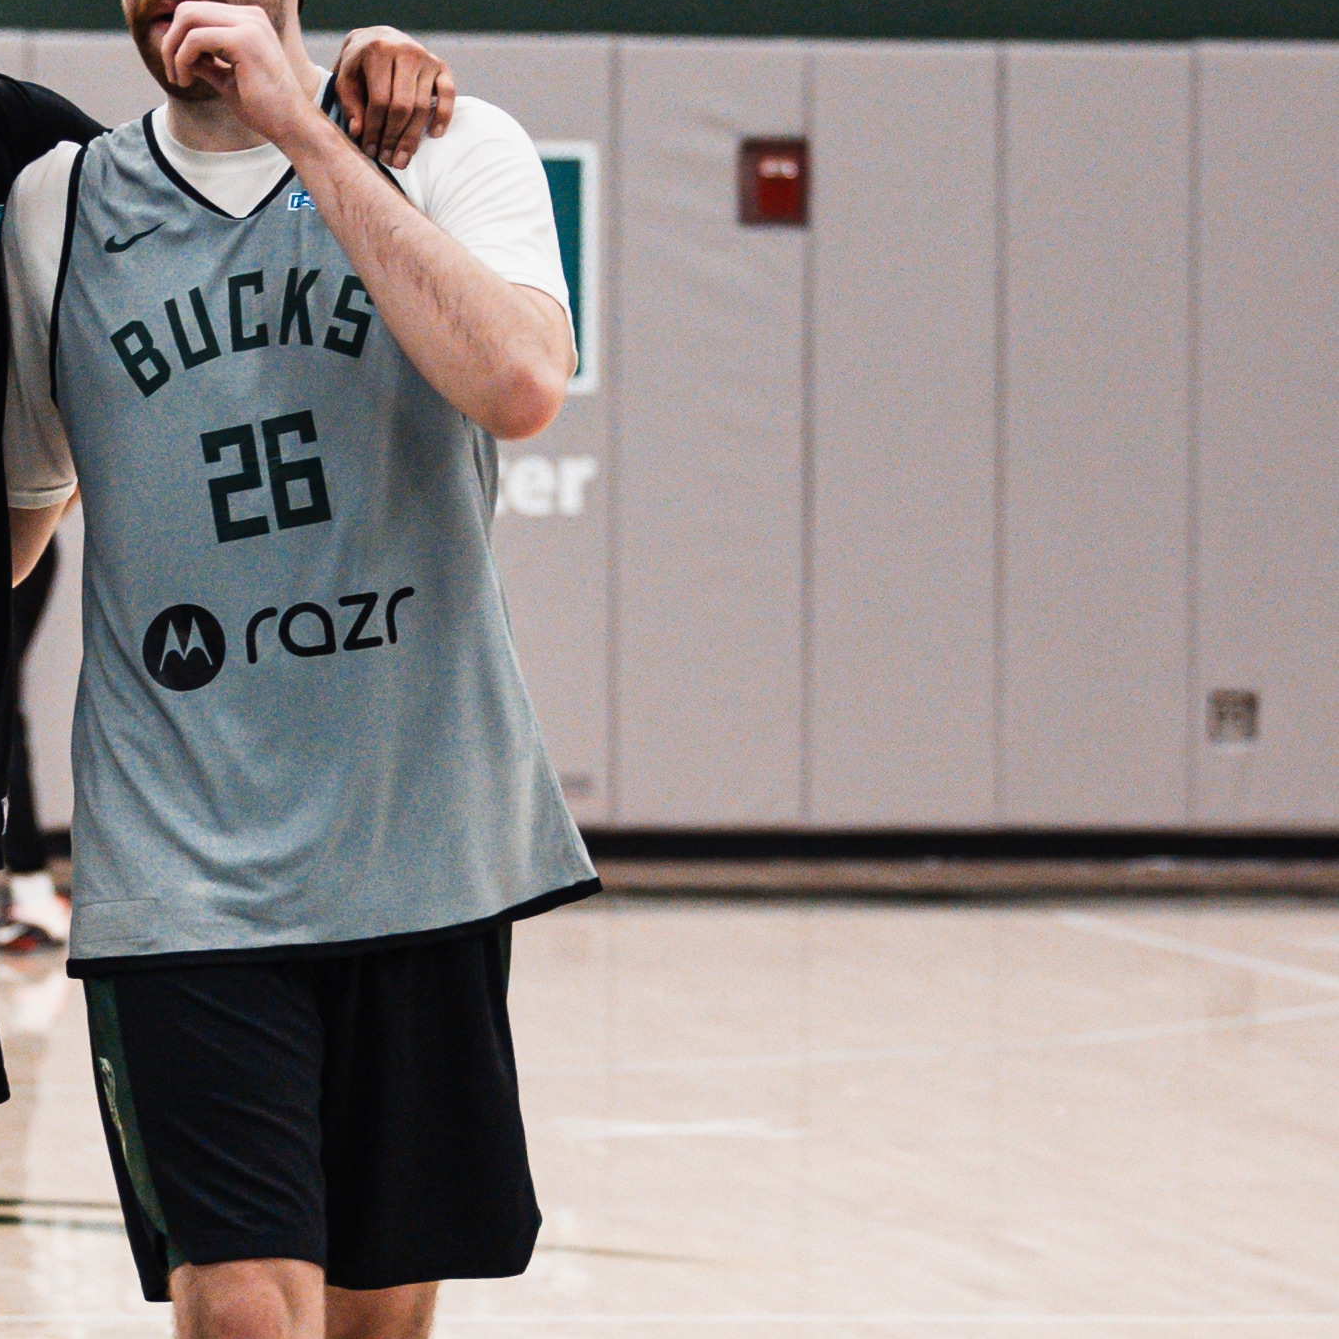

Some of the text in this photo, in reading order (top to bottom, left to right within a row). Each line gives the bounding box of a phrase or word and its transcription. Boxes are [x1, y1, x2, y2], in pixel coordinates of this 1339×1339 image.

[110, 267, 373, 398] BUCKS
[200, 409, 332, 544] 26
[495, 454, 599, 519] er
[245, 586, 415, 665] razr
